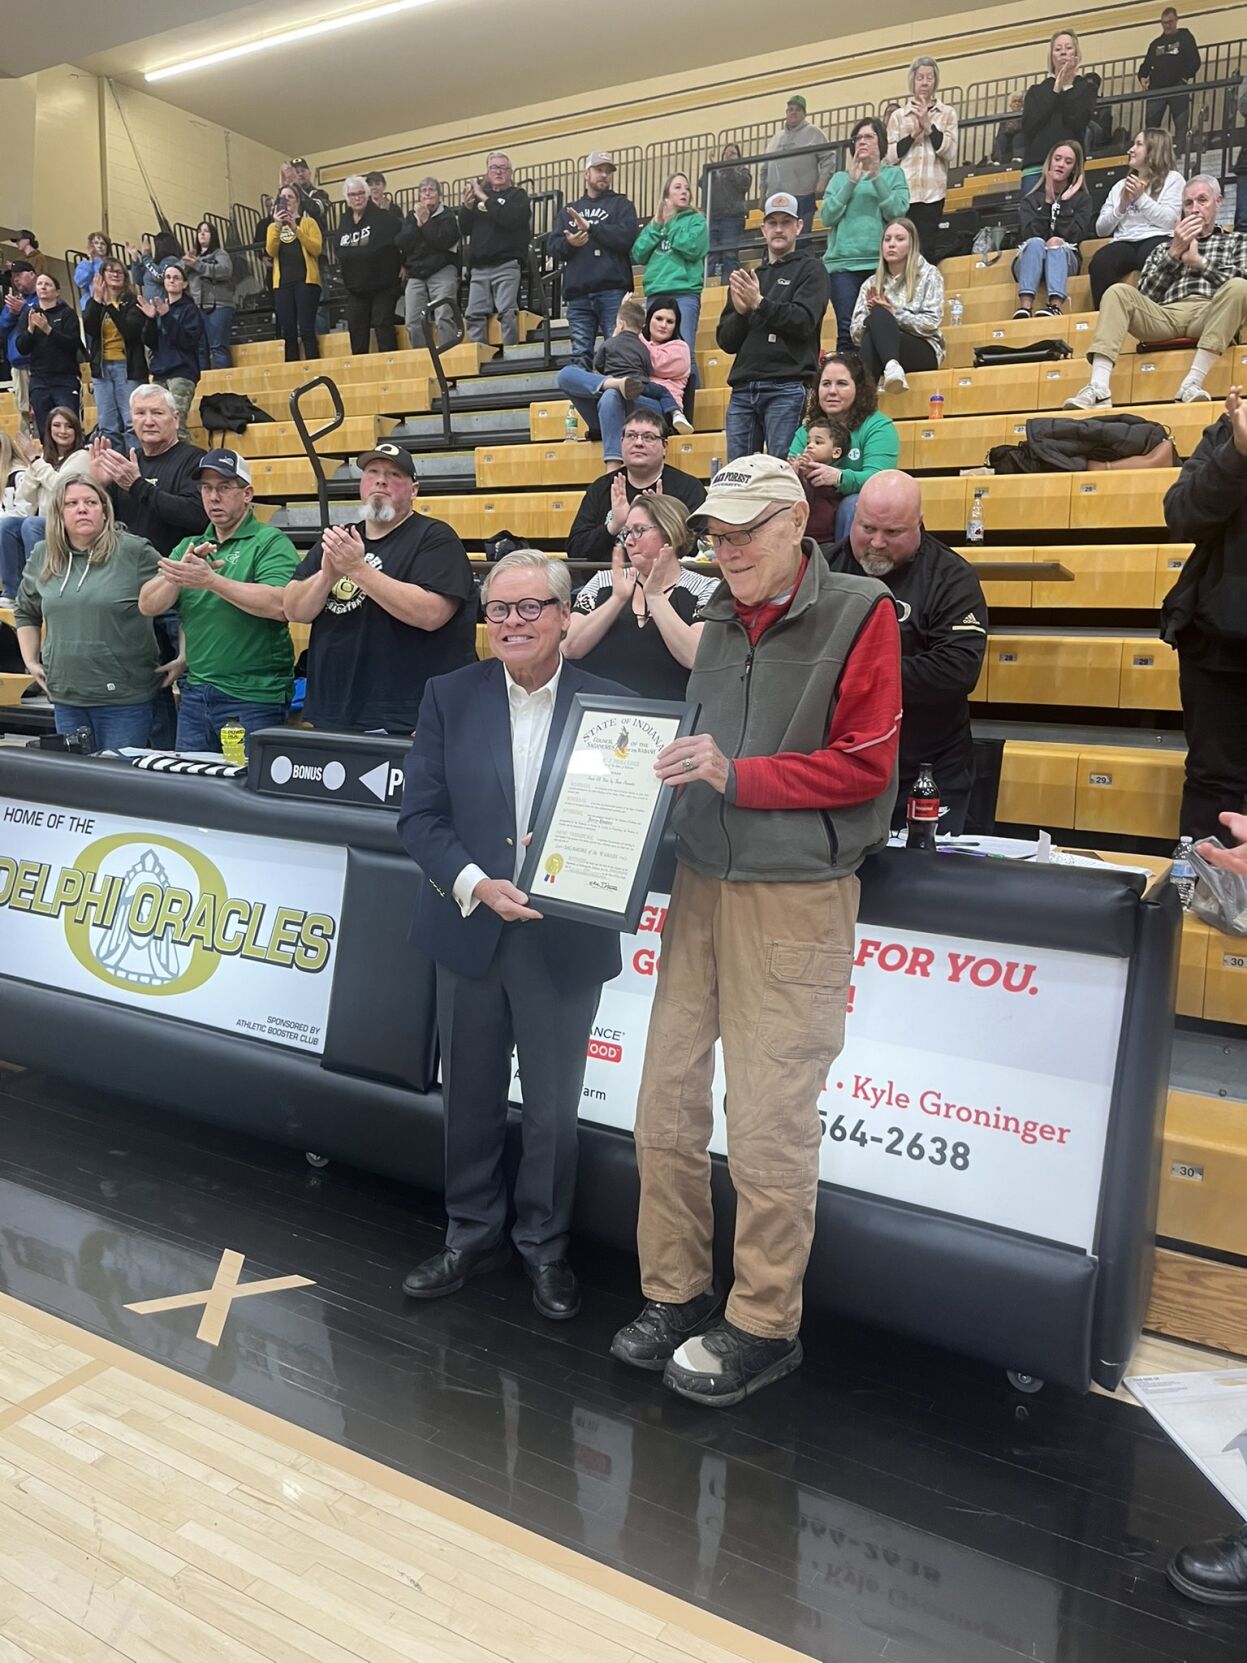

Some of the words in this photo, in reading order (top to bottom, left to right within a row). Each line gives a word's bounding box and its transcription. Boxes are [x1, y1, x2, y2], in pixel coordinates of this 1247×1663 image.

[583, 718, 617, 743] STATE
[632, 718, 665, 752] INDIANA
[292, 764, 324, 782] BONUS
[1095, 776, 1107, 784] 29
[3, 807, 45, 827] HOME
[46, 813, 66, 830] OF
[69, 816, 96, 835] THE
[0, 856, 126, 929] DELPHI
[128, 882, 336, 974] ORACLES
[853, 938, 936, 978] FOR
[946, 952, 1039, 996] YOU.
[1230, 957, 1244, 967] 30
[235, 1019, 267, 1033] ATHLETIC
[267, 1026, 299, 1041] BOOSTER
[299, 1034, 320, 1046] CLUB
[266, 1015, 309, 1033] SPONSORED
[309, 1026, 321, 1035] BY
[852, 1074, 911, 1109] Kyle
[919, 1090, 1072, 1145] Groninger
[1179, 1166, 1195, 1178] 30
